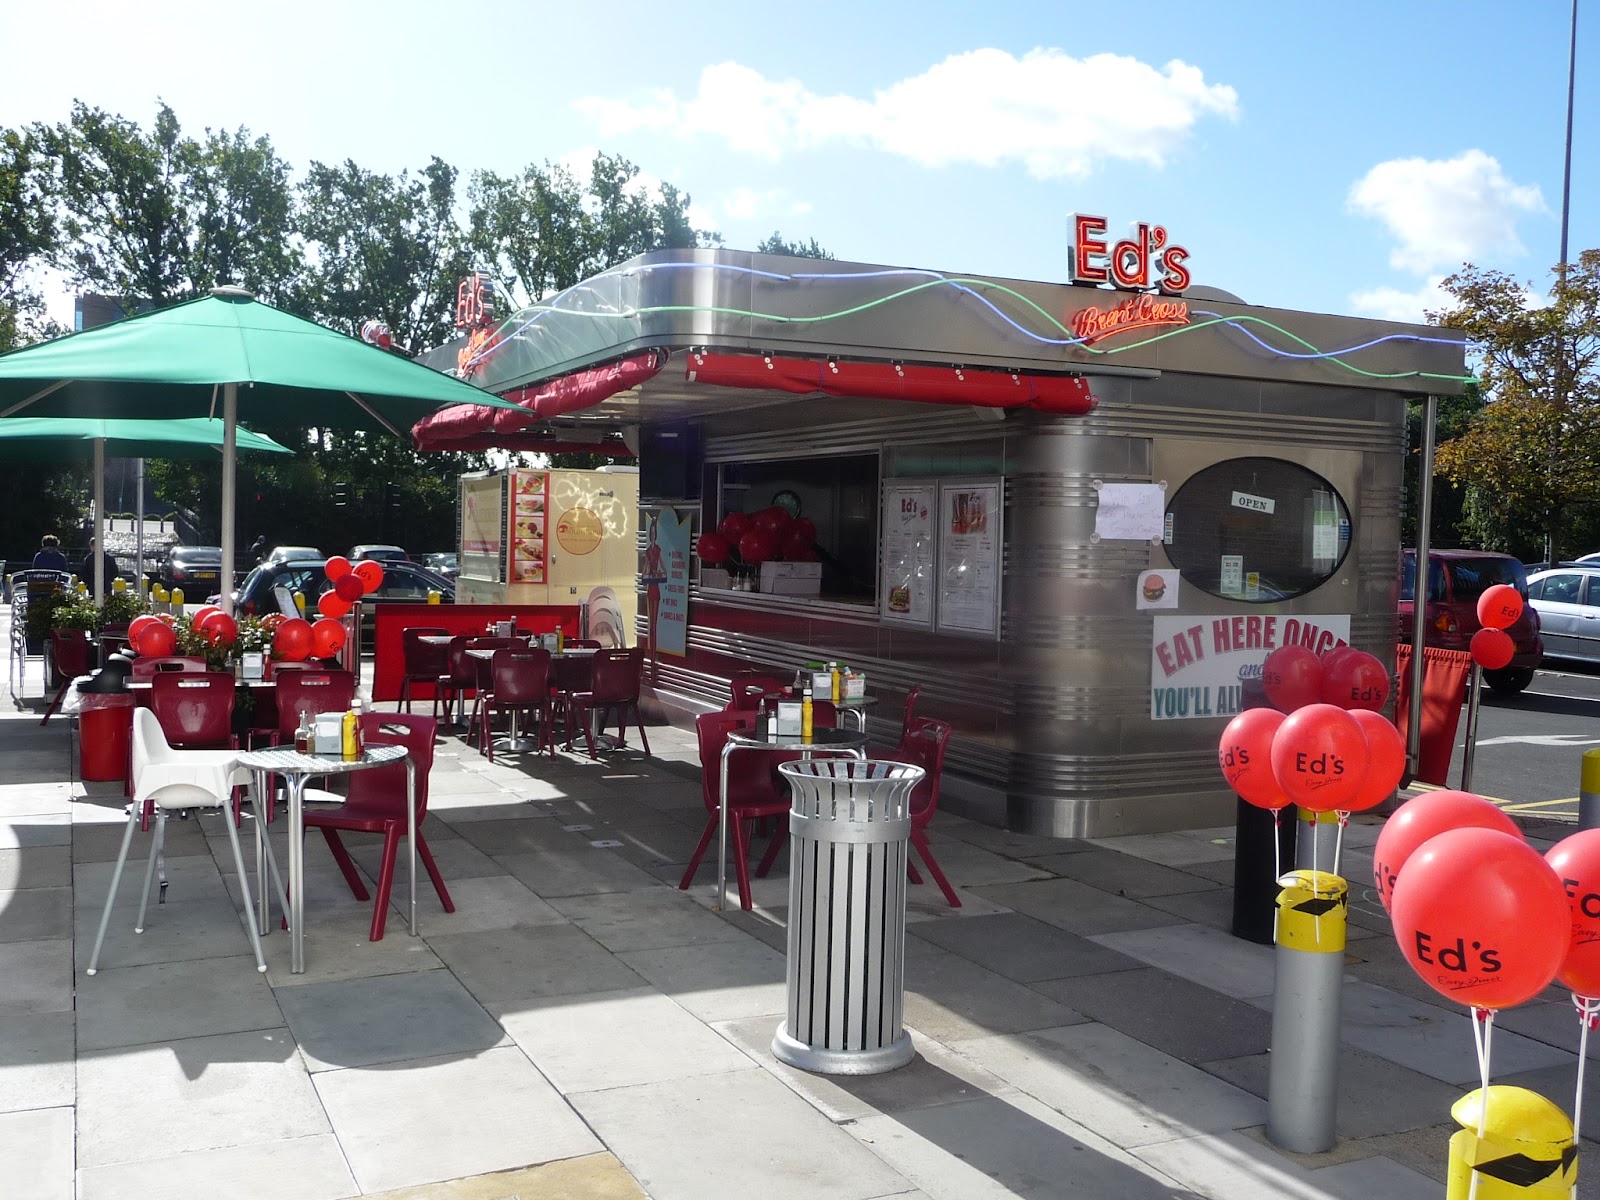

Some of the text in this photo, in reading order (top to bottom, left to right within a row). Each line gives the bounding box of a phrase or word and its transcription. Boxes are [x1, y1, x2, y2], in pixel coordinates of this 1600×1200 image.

[1070, 212, 1191, 292] Ed's
[1075, 294, 1190, 337] Brent Cross
[1238, 496, 1267, 510] OPEN
[1155, 624, 1205, 678] EAT
[1212, 616, 1276, 655] HERE
[1153, 686, 1212, 718] YOU'LL
[1351, 687, 1382, 701] Ed's
[1296, 752, 1344, 775] Ed's
[1374, 862, 1398, 896] d's
[1415, 930, 1502, 973] Ed's
